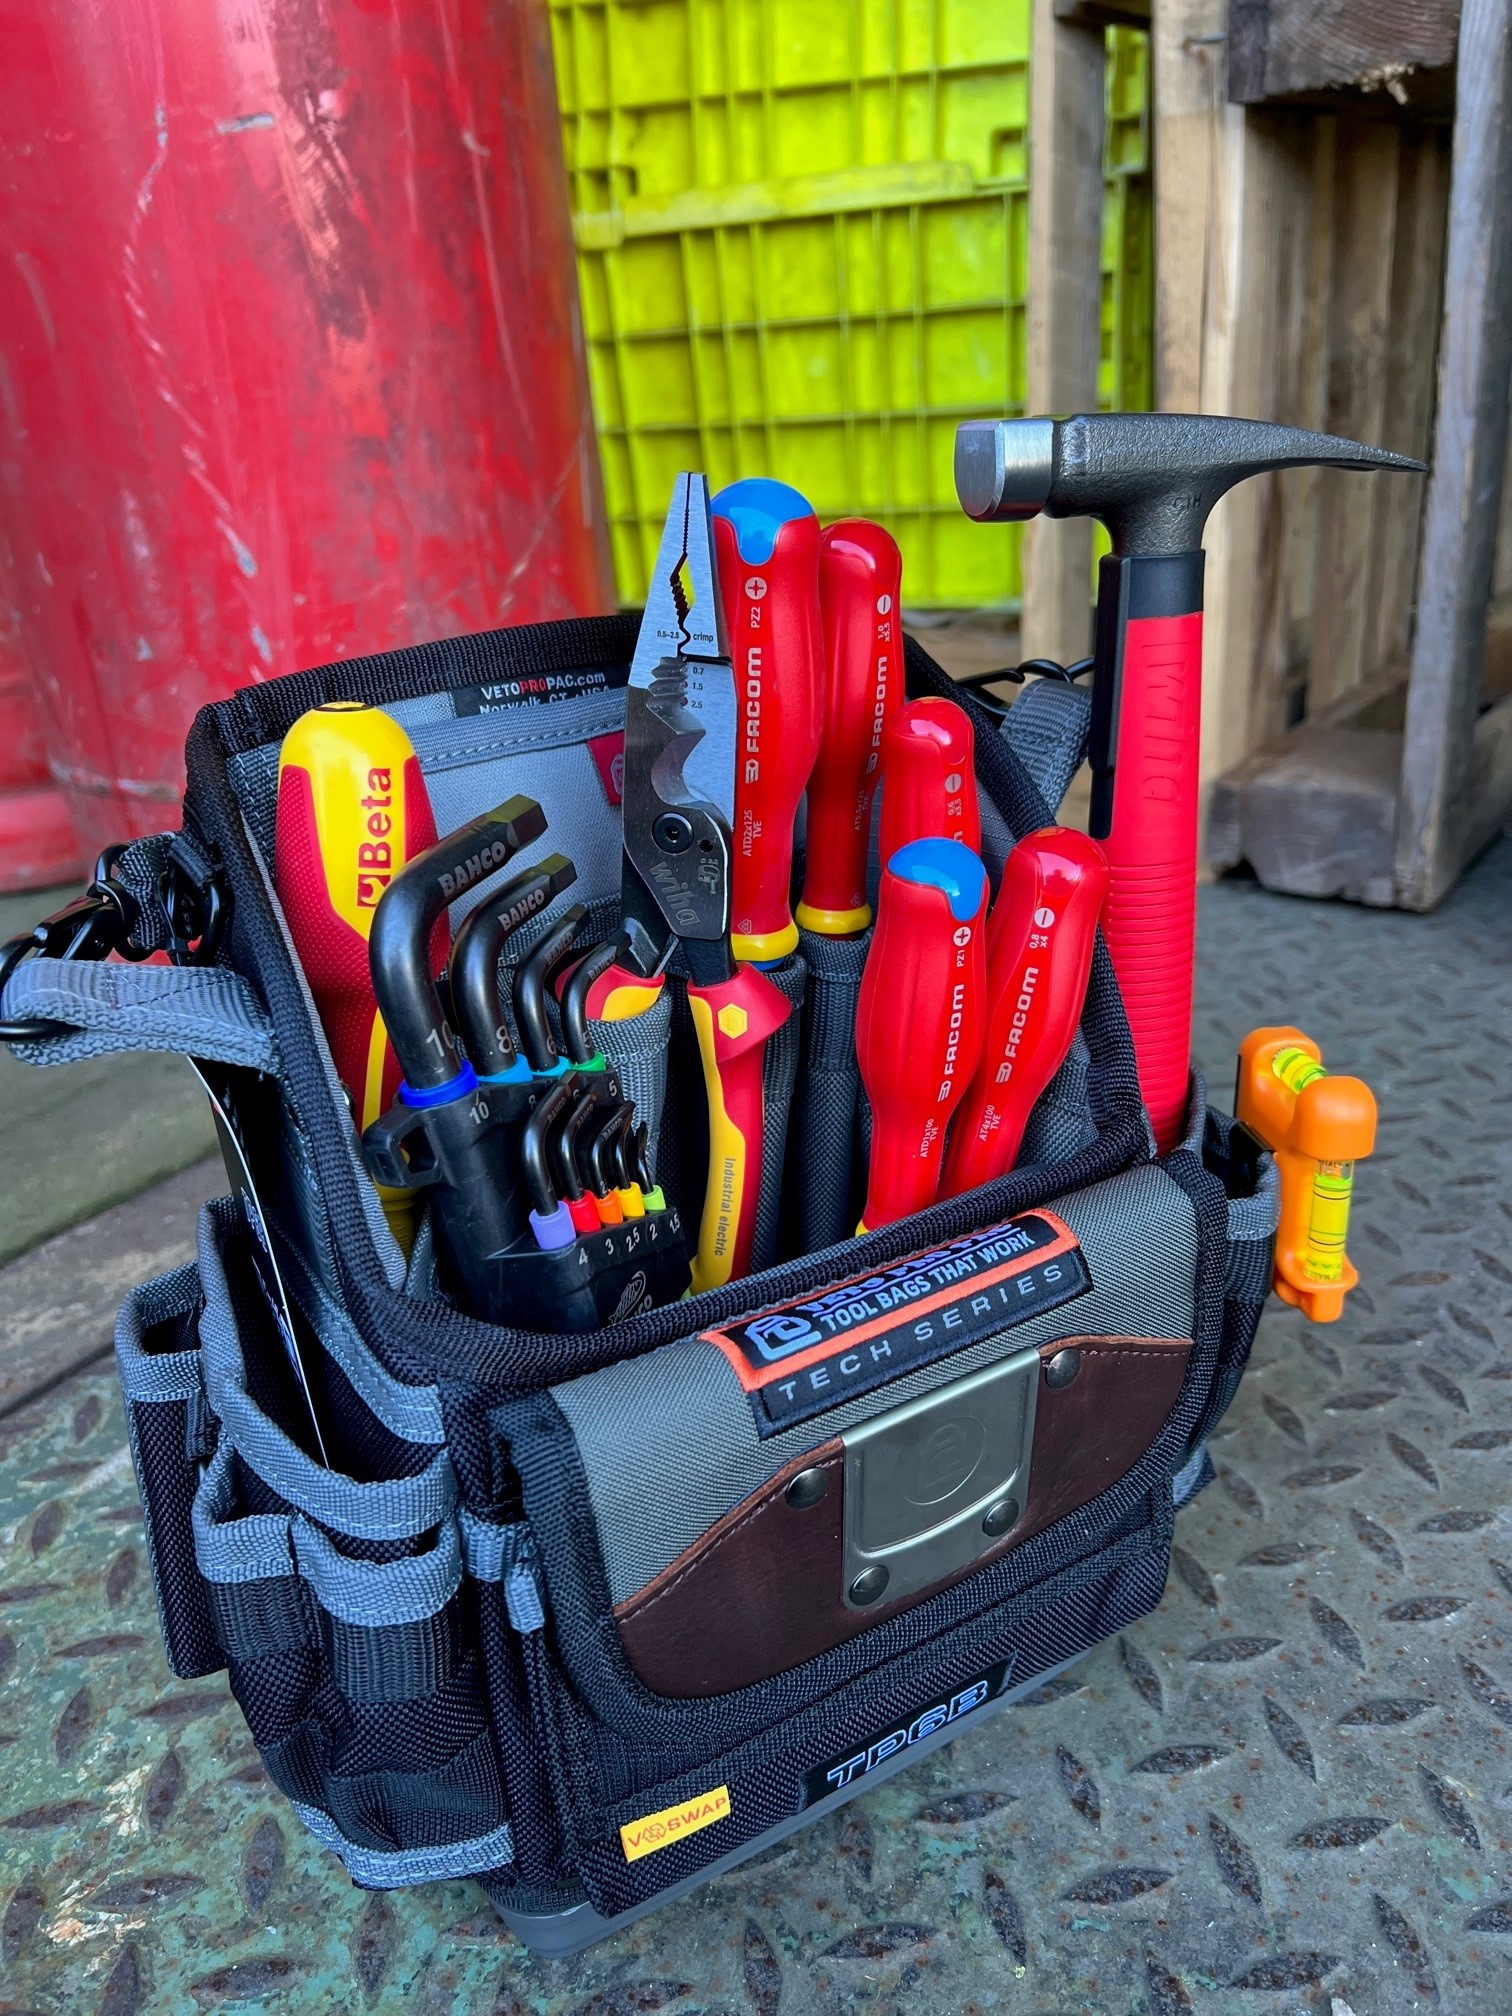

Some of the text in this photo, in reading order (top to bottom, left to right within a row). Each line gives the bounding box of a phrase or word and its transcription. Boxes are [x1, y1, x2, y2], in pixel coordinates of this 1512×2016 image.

[750, 606, 761, 628] PZ2
[692, 633, 714, 643] crimp
[692, 666, 704, 675] 0.7
[480, 672, 606, 700] VETOPROPAC.com
[692, 682, 704, 690] 1.5
[691, 700, 703, 709] 2.5
[358, 767, 392, 869] Beta
[753, 820, 762, 839] TVE
[437, 841, 506, 898] BAHCO
[649, 861, 701, 926] wiha
[497, 888, 545, 932] BAHCO
[956, 949, 965, 968] PZ1
[426, 1020, 455, 1058] 10
[495, 1025, 512, 1054] 8
[582, 1030, 593, 1049] 5
[608, 1079, 618, 1097] 5
[469, 1101, 490, 1125] 10
[978, 1104, 995, 1142] AT4x100
[990, 1113, 1002, 1131] TVE
[919, 1118, 935, 1159] ATD1x100
[931, 1125, 939, 1142] TVE
[714, 1157, 737, 1257] Industrial electric
[578, 1213, 681, 1266] 4 3 2.5 2 1.5
[819, 1230, 1037, 1332] TOOL BAGS THAT WORK
[778, 1264, 1063, 1401] TECH SERIES
[826, 1679, 989, 1788] TP6B
